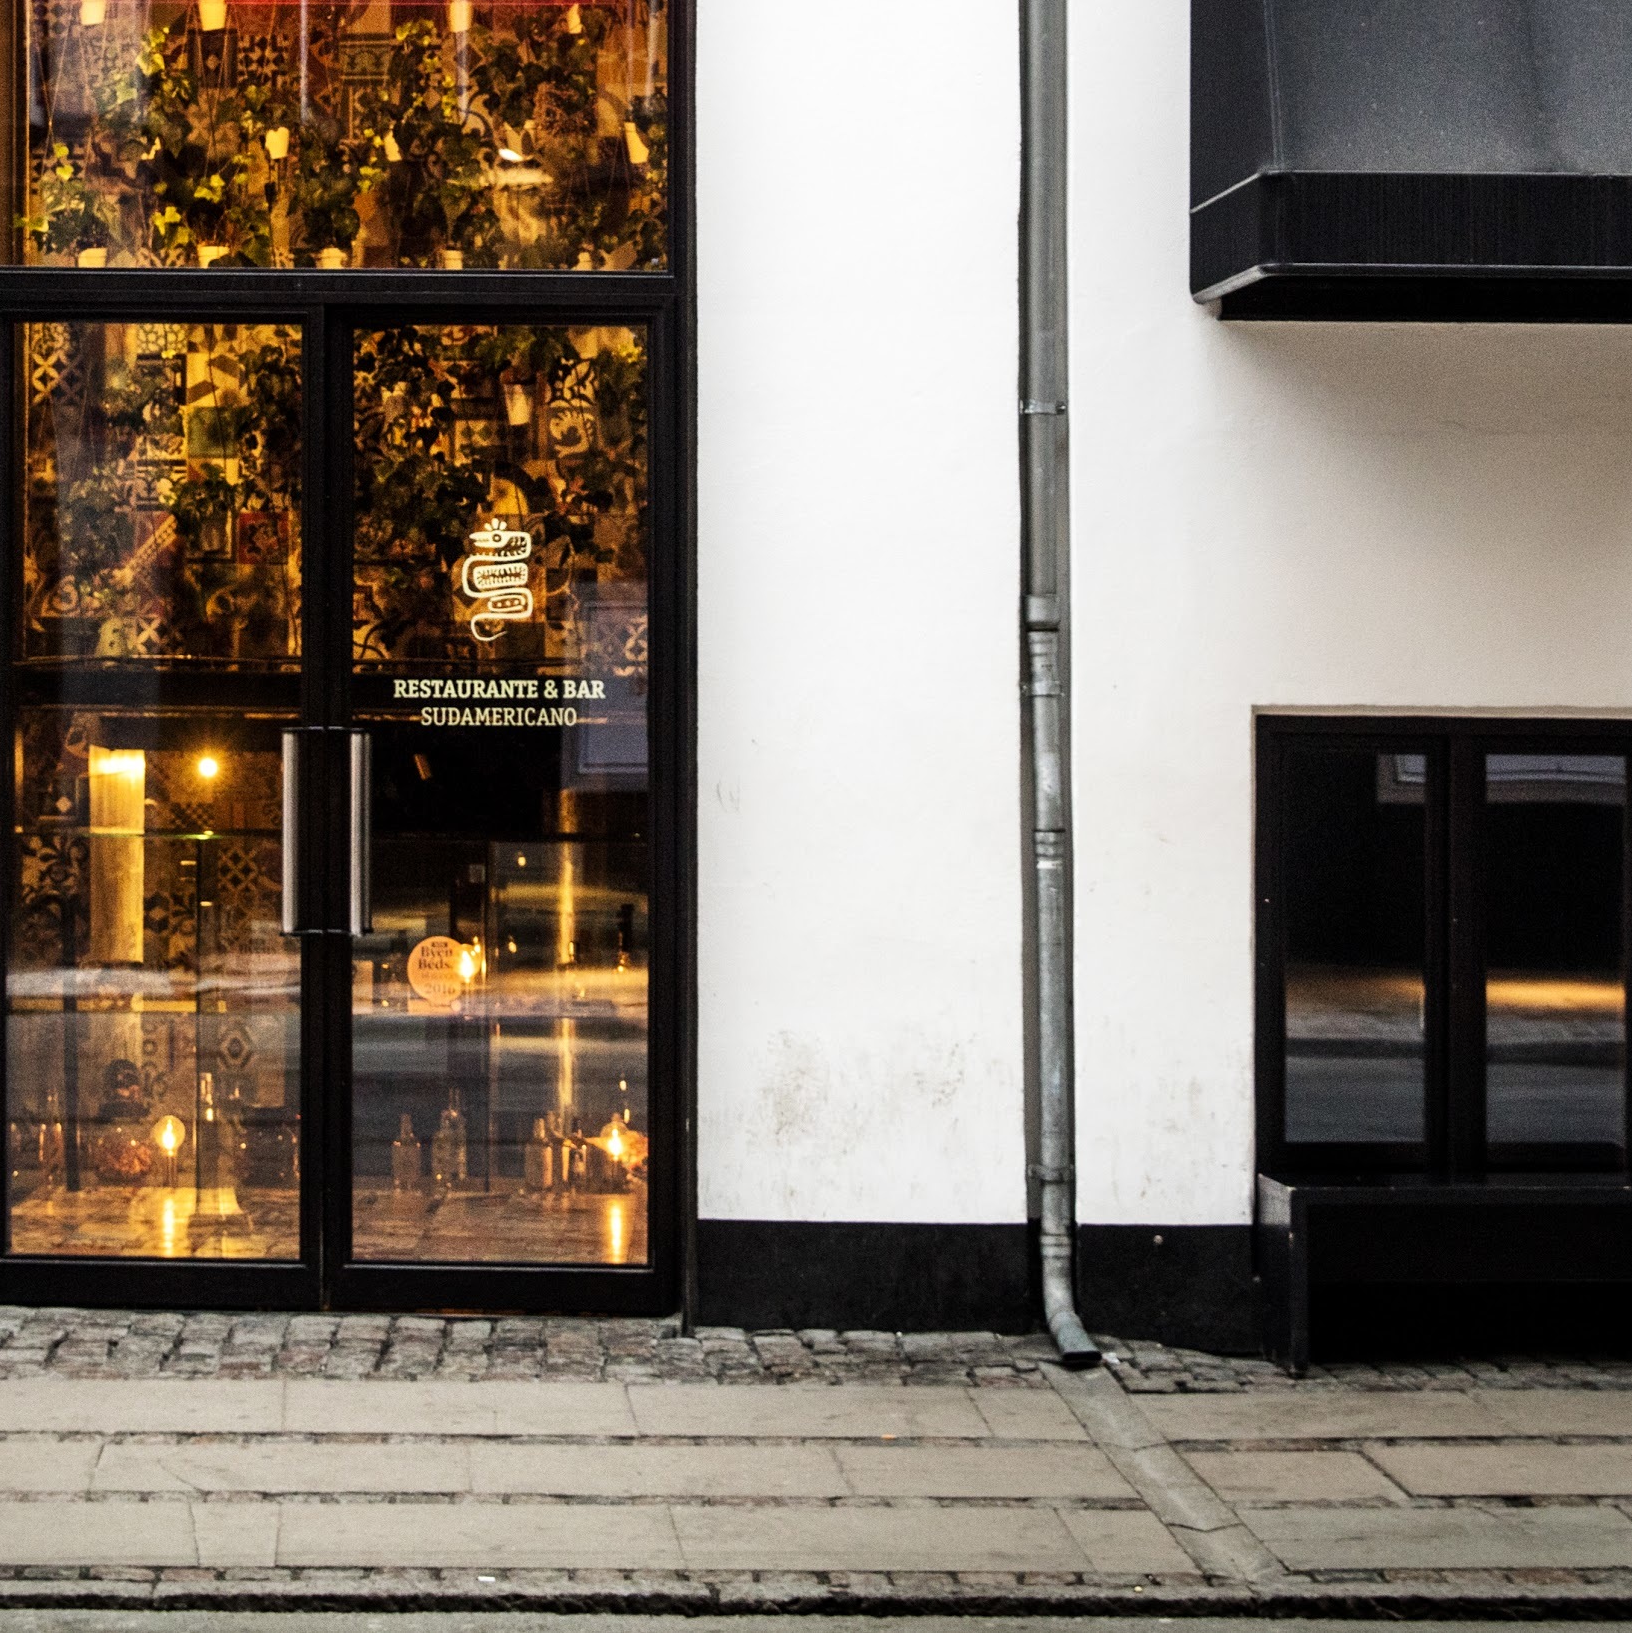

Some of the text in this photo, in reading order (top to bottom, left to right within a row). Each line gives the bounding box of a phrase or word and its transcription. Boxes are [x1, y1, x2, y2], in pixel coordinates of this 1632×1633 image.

[393, 679, 606, 699] RESTAURANTE & BAR
[420, 706, 578, 727] SUDAMERICANO
